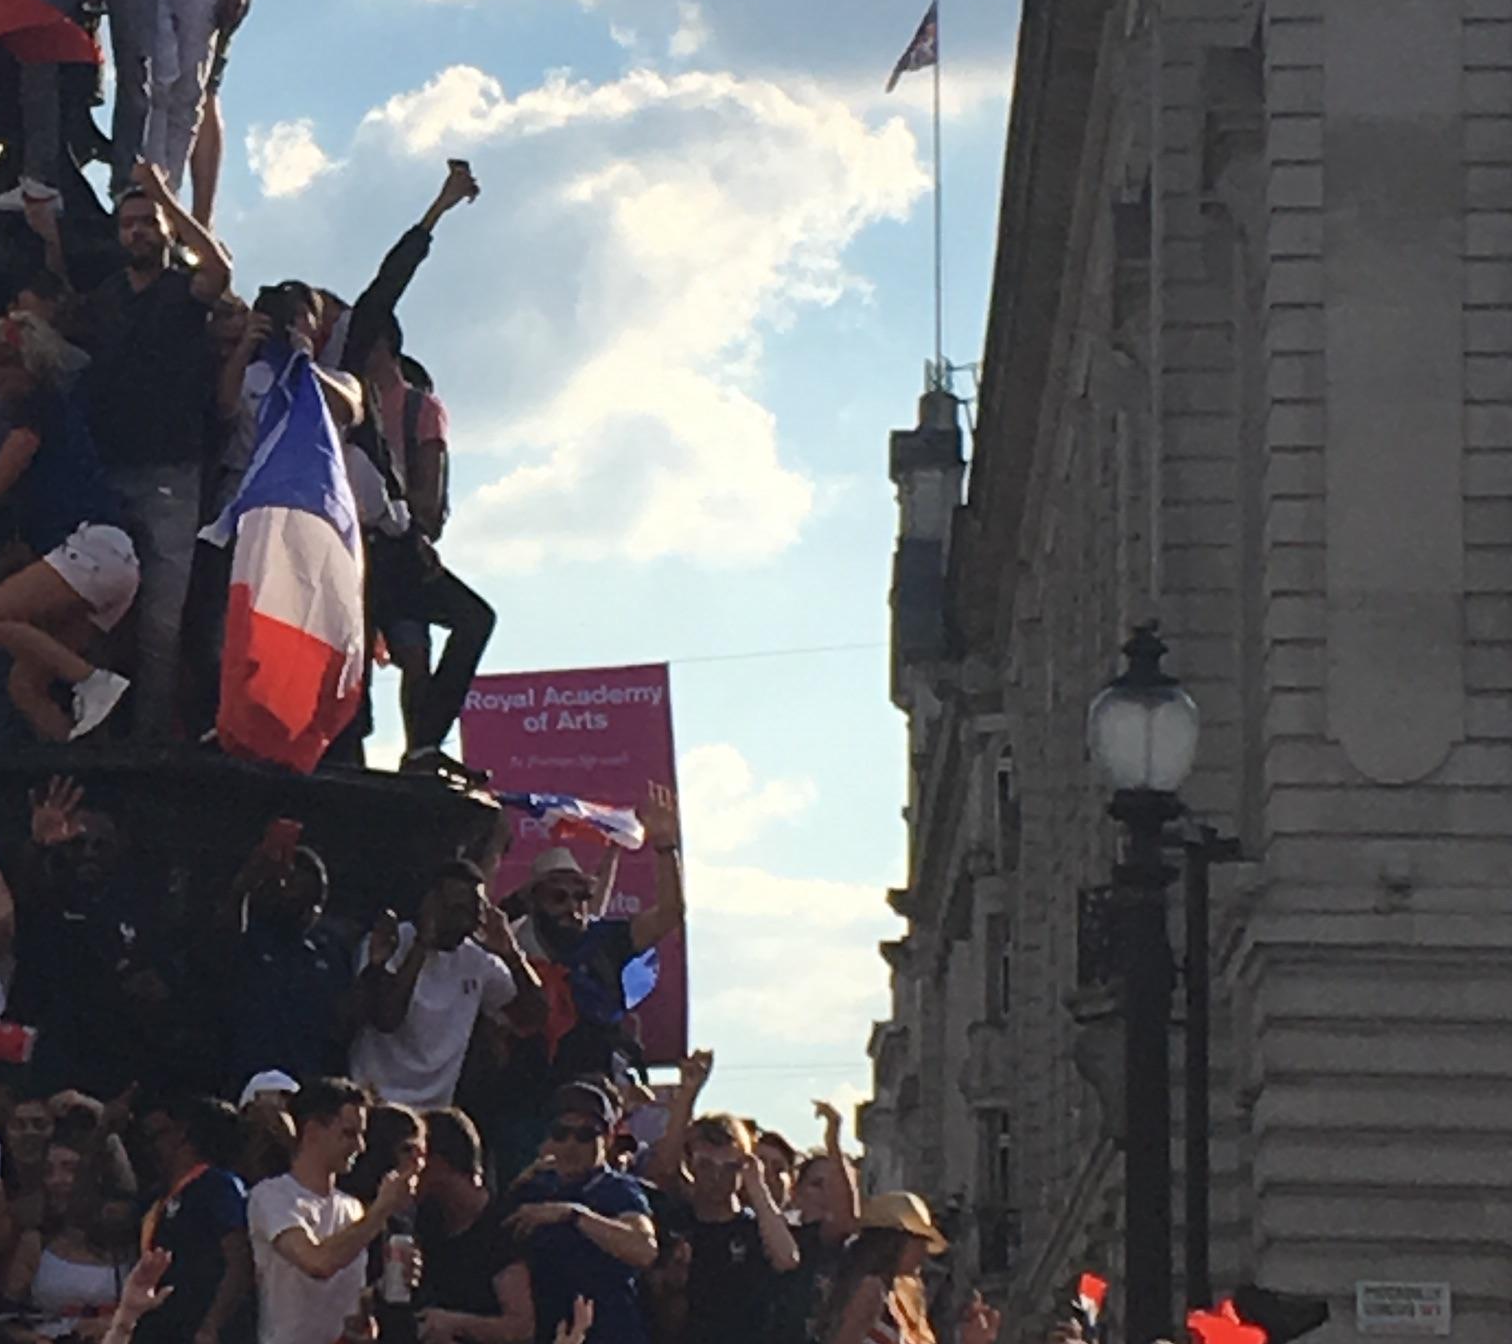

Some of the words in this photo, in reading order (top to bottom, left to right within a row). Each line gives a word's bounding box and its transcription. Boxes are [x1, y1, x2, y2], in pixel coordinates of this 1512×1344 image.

[465, 688, 535, 713] Royal
[543, 684, 663, 707] Academy
[523, 712, 548, 733] of
[556, 710, 608, 731] Arts
